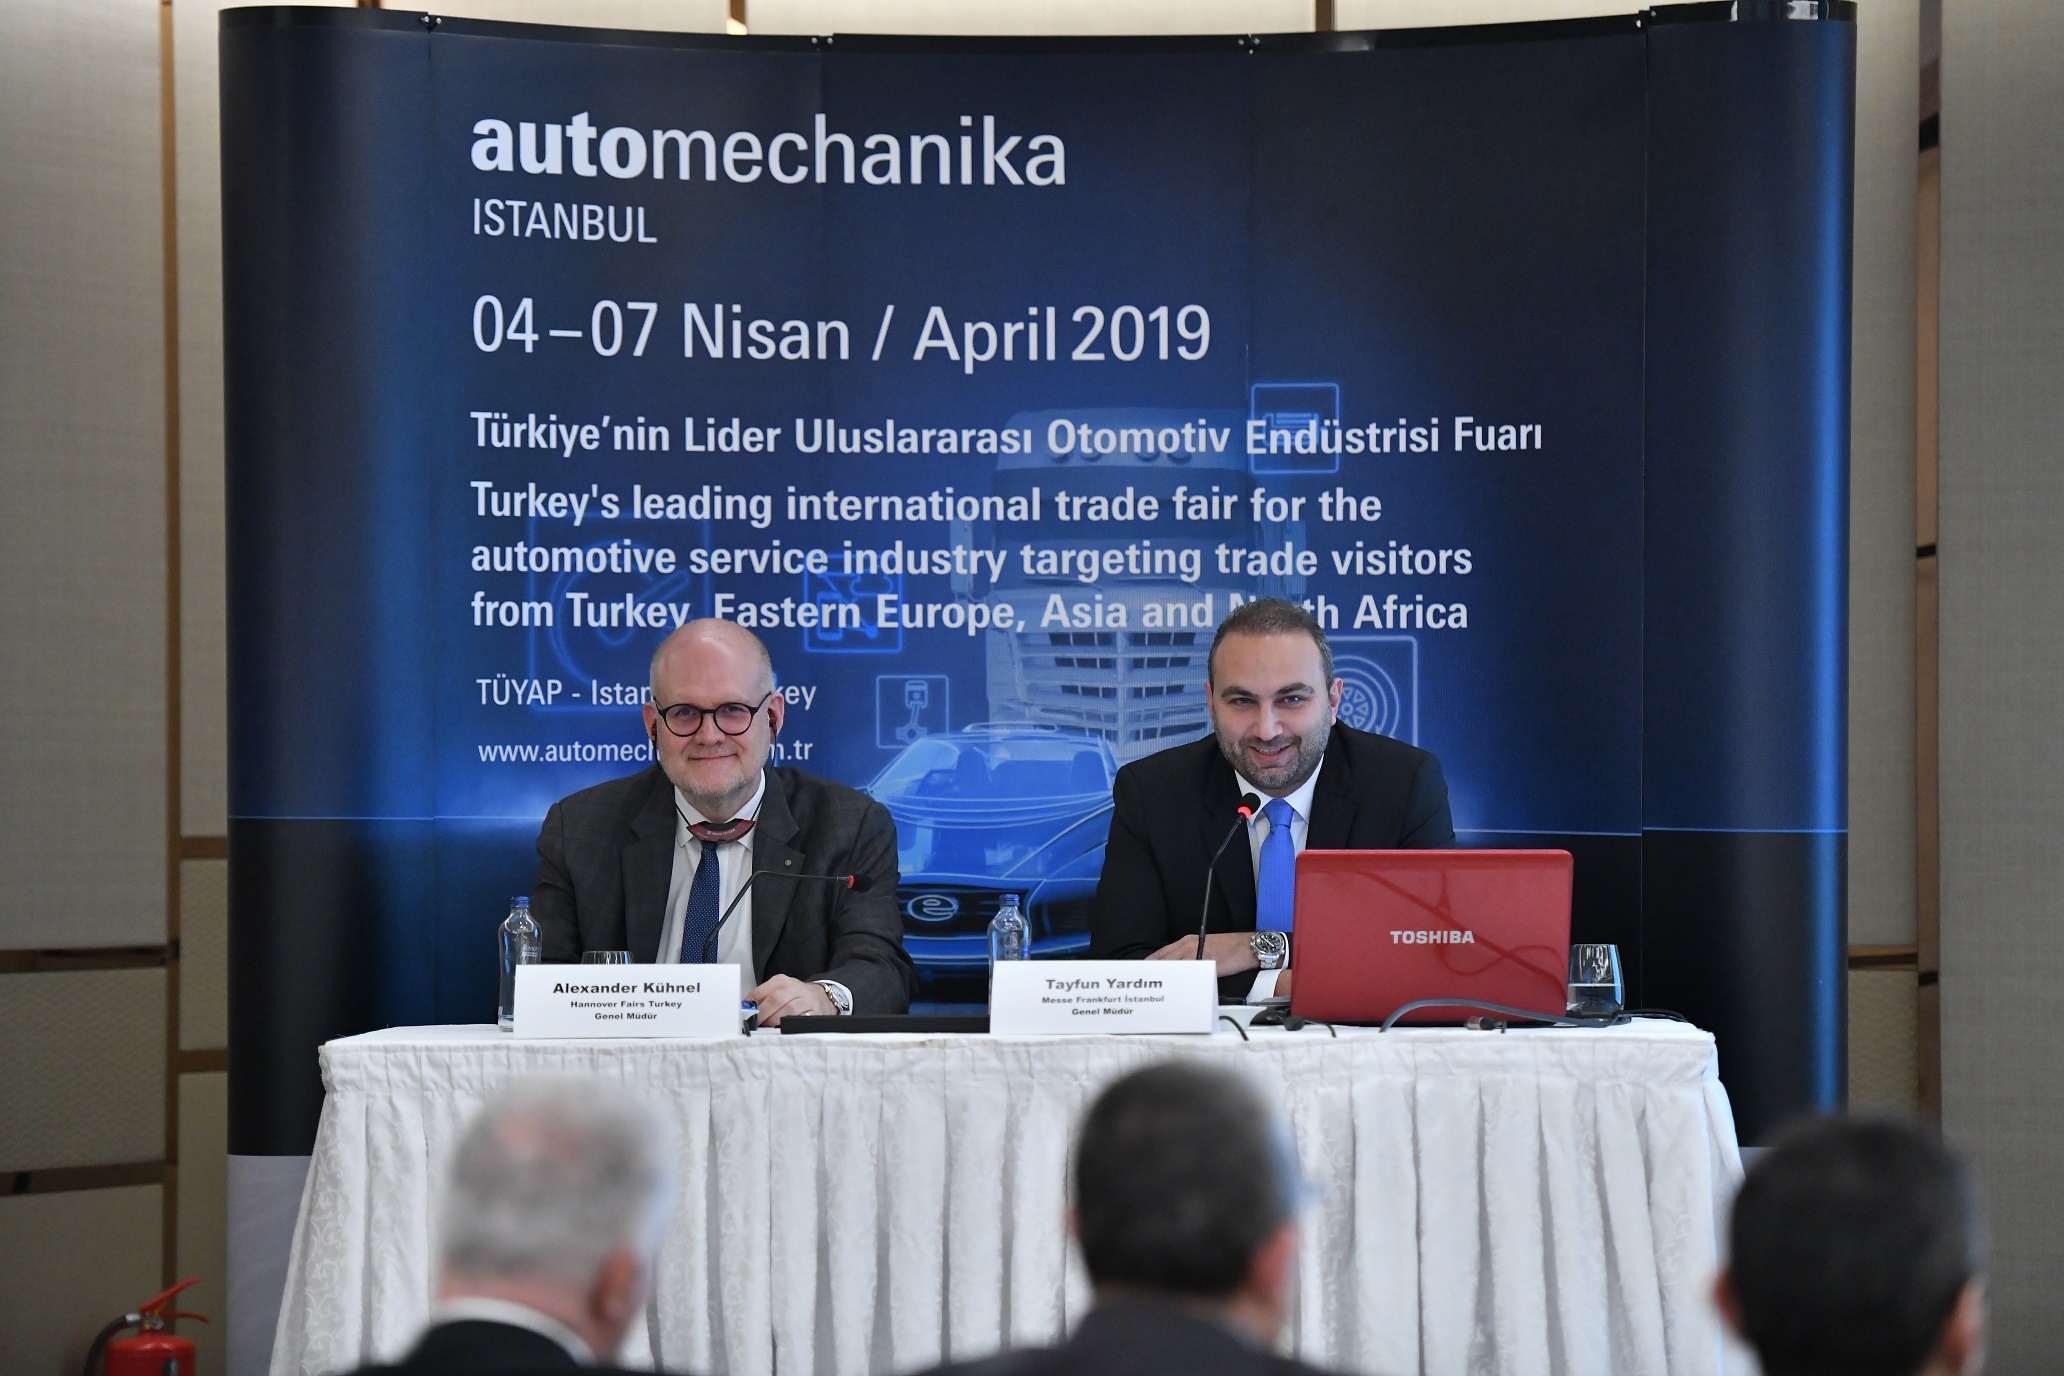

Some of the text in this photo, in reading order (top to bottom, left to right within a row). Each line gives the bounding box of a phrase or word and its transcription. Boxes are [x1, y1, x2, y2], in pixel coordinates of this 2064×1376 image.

[470, 111, 1067, 187] automechanika
[473, 198, 658, 244] ISTANBUL
[683, 302, 850, 360] Nisan
[871, 304, 896, 361] /
[913, 305, 1057, 375] April
[1071, 304, 1211, 362] 2019
[470, 411, 1543, 458] Türkiye’nin Lider Uluslararası Otomotiv Endüstrisi Fuarı
[470, 481, 1383, 529] Turkey's leading international trade fair for the
[471, 538, 1473, 583] automotive service industry targeting trade visitors
[471, 591, 554, 628] from
[714, 593, 861, 629] Eastern
[877, 594, 1026, 637] Europe,
[1040, 593, 1129, 629] Asia
[1142, 593, 1214, 629] and
[1353, 594, 1469, 629] Africa
[476, 673, 563, 706] TÜYAP
[591, 679, 654, 706] Istan
[1390, 930, 1475, 945] TOSHIBA
[553, 982, 701, 994] Alexander Kühnel
[1046, 978, 1163, 992] Tayfun Yardım
[594, 1012, 657, 1020] Genel Müdür
[648, 1001, 682, 1009] Turkey
[1072, 1008, 1100, 1016] Genel
